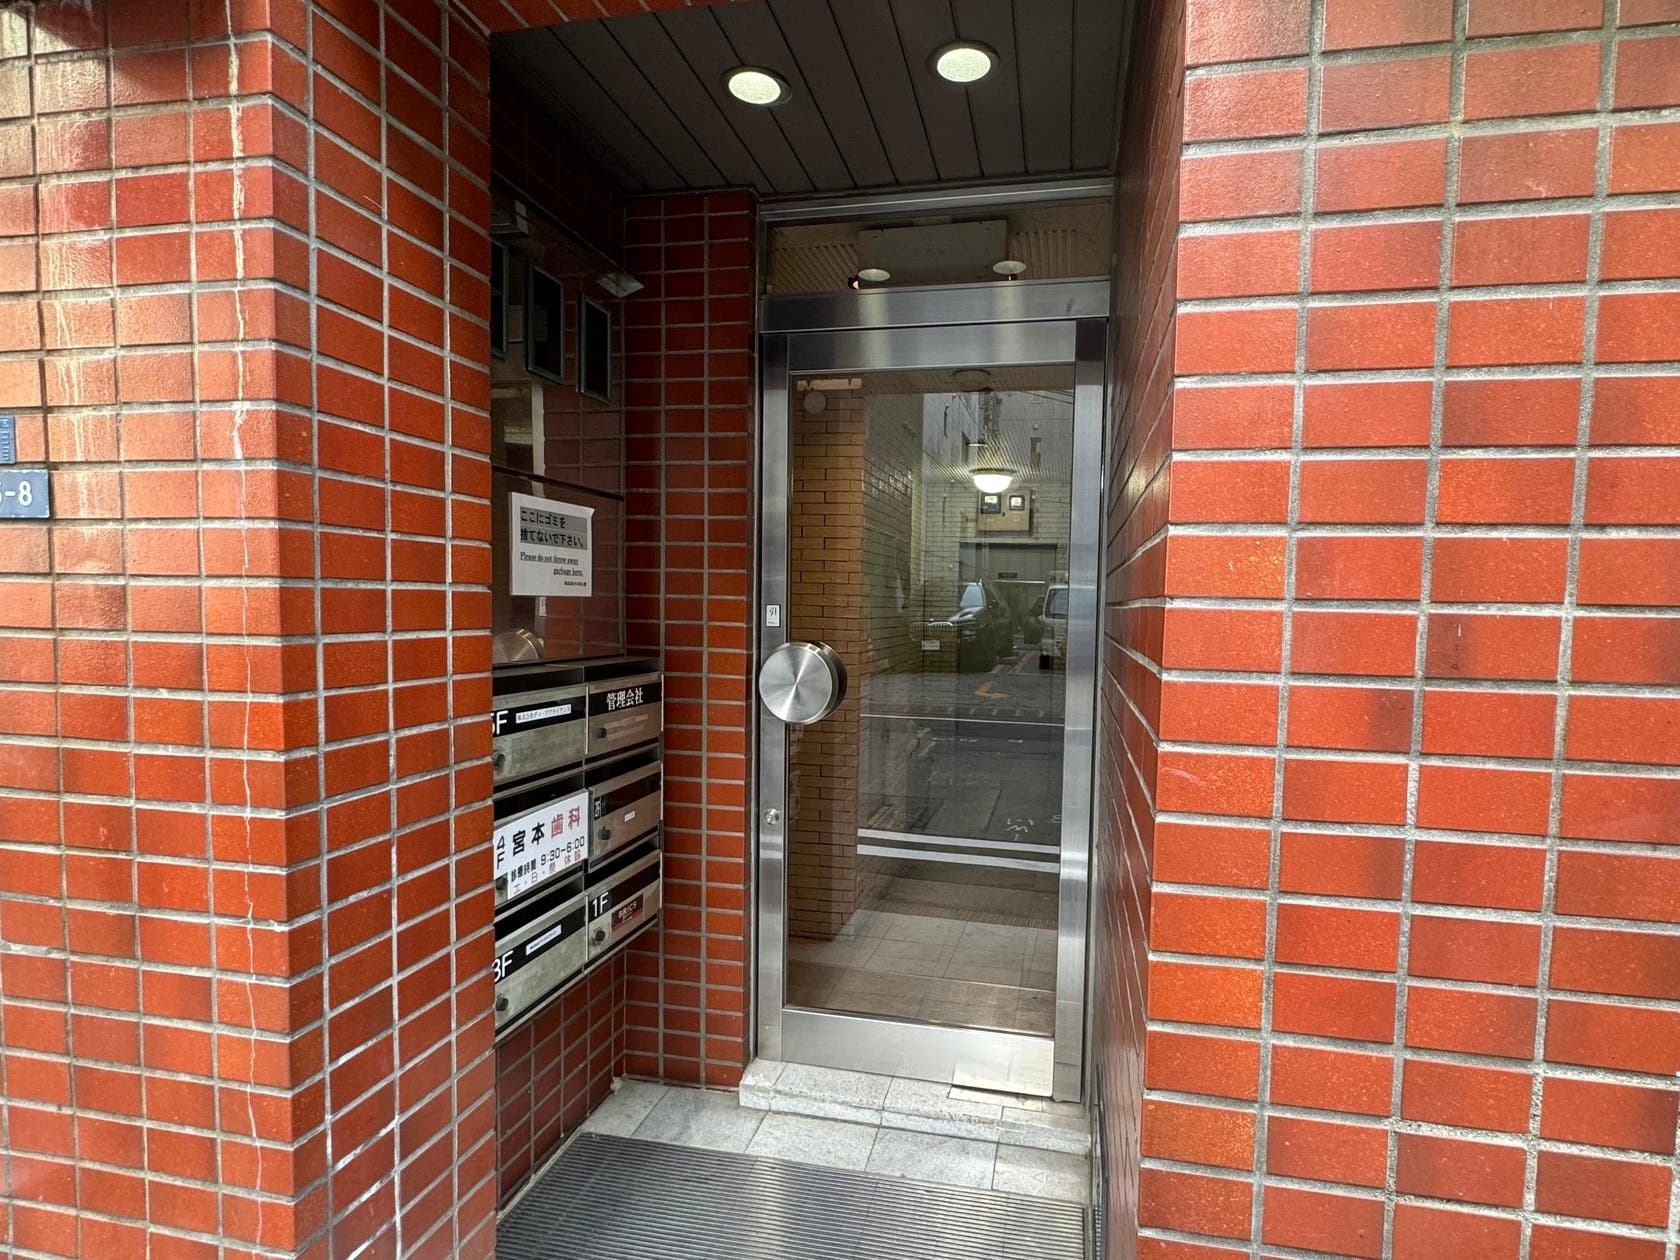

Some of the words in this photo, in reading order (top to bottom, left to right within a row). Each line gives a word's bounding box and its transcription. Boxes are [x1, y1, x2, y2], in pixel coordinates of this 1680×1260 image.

[0, 481, 33, 507] -8
[520, 510, 566, 529] ここにゴミを
[520, 528, 584, 548] 捨てないで下さい。
[606, 687, 644, 711] 管理会社
[512, 805, 580, 857] 宮本歯科
[511, 858, 537, 882] 診療時間
[592, 891, 609, 917] 1F
[491, 950, 513, 983] 3F
